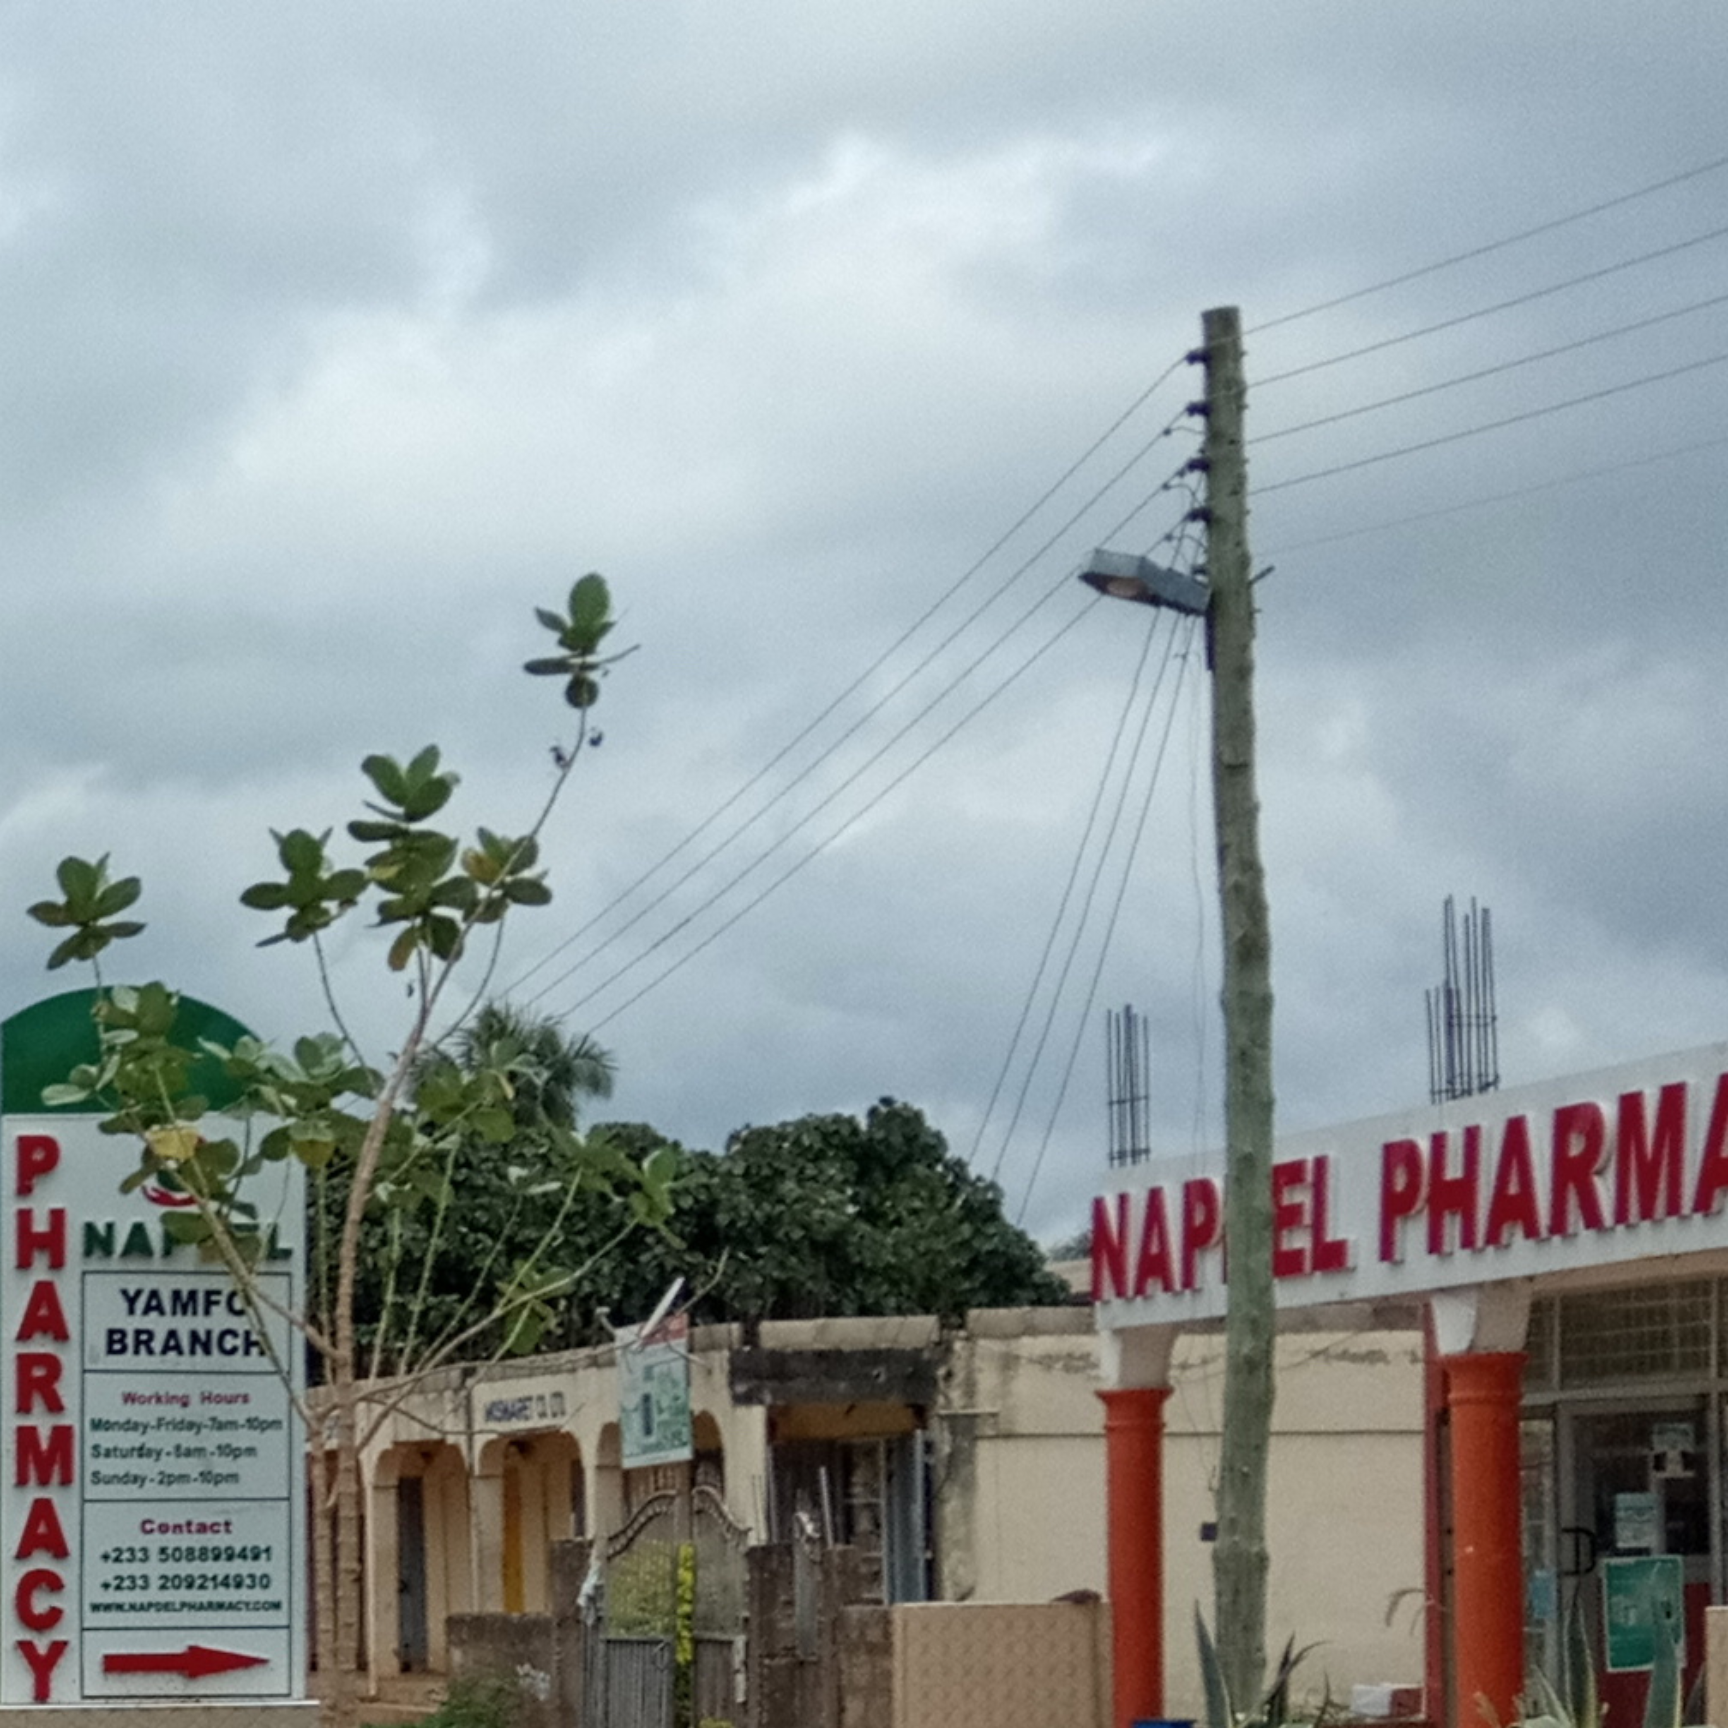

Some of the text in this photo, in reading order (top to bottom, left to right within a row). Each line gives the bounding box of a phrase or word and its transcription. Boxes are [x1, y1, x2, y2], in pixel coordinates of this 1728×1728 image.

[1090, 1152, 1350, 1303] NAPEL
[105, 1327, 267, 1356] BRANCH
[122, 1391, 250, 1408] Working Hours
[14, 1134, 75, 1704] PHARMACY
[140, 1519, 232, 1535] Contact
[100, 1547, 149, 1564] +233
[100, 1575, 149, 1591] +233
